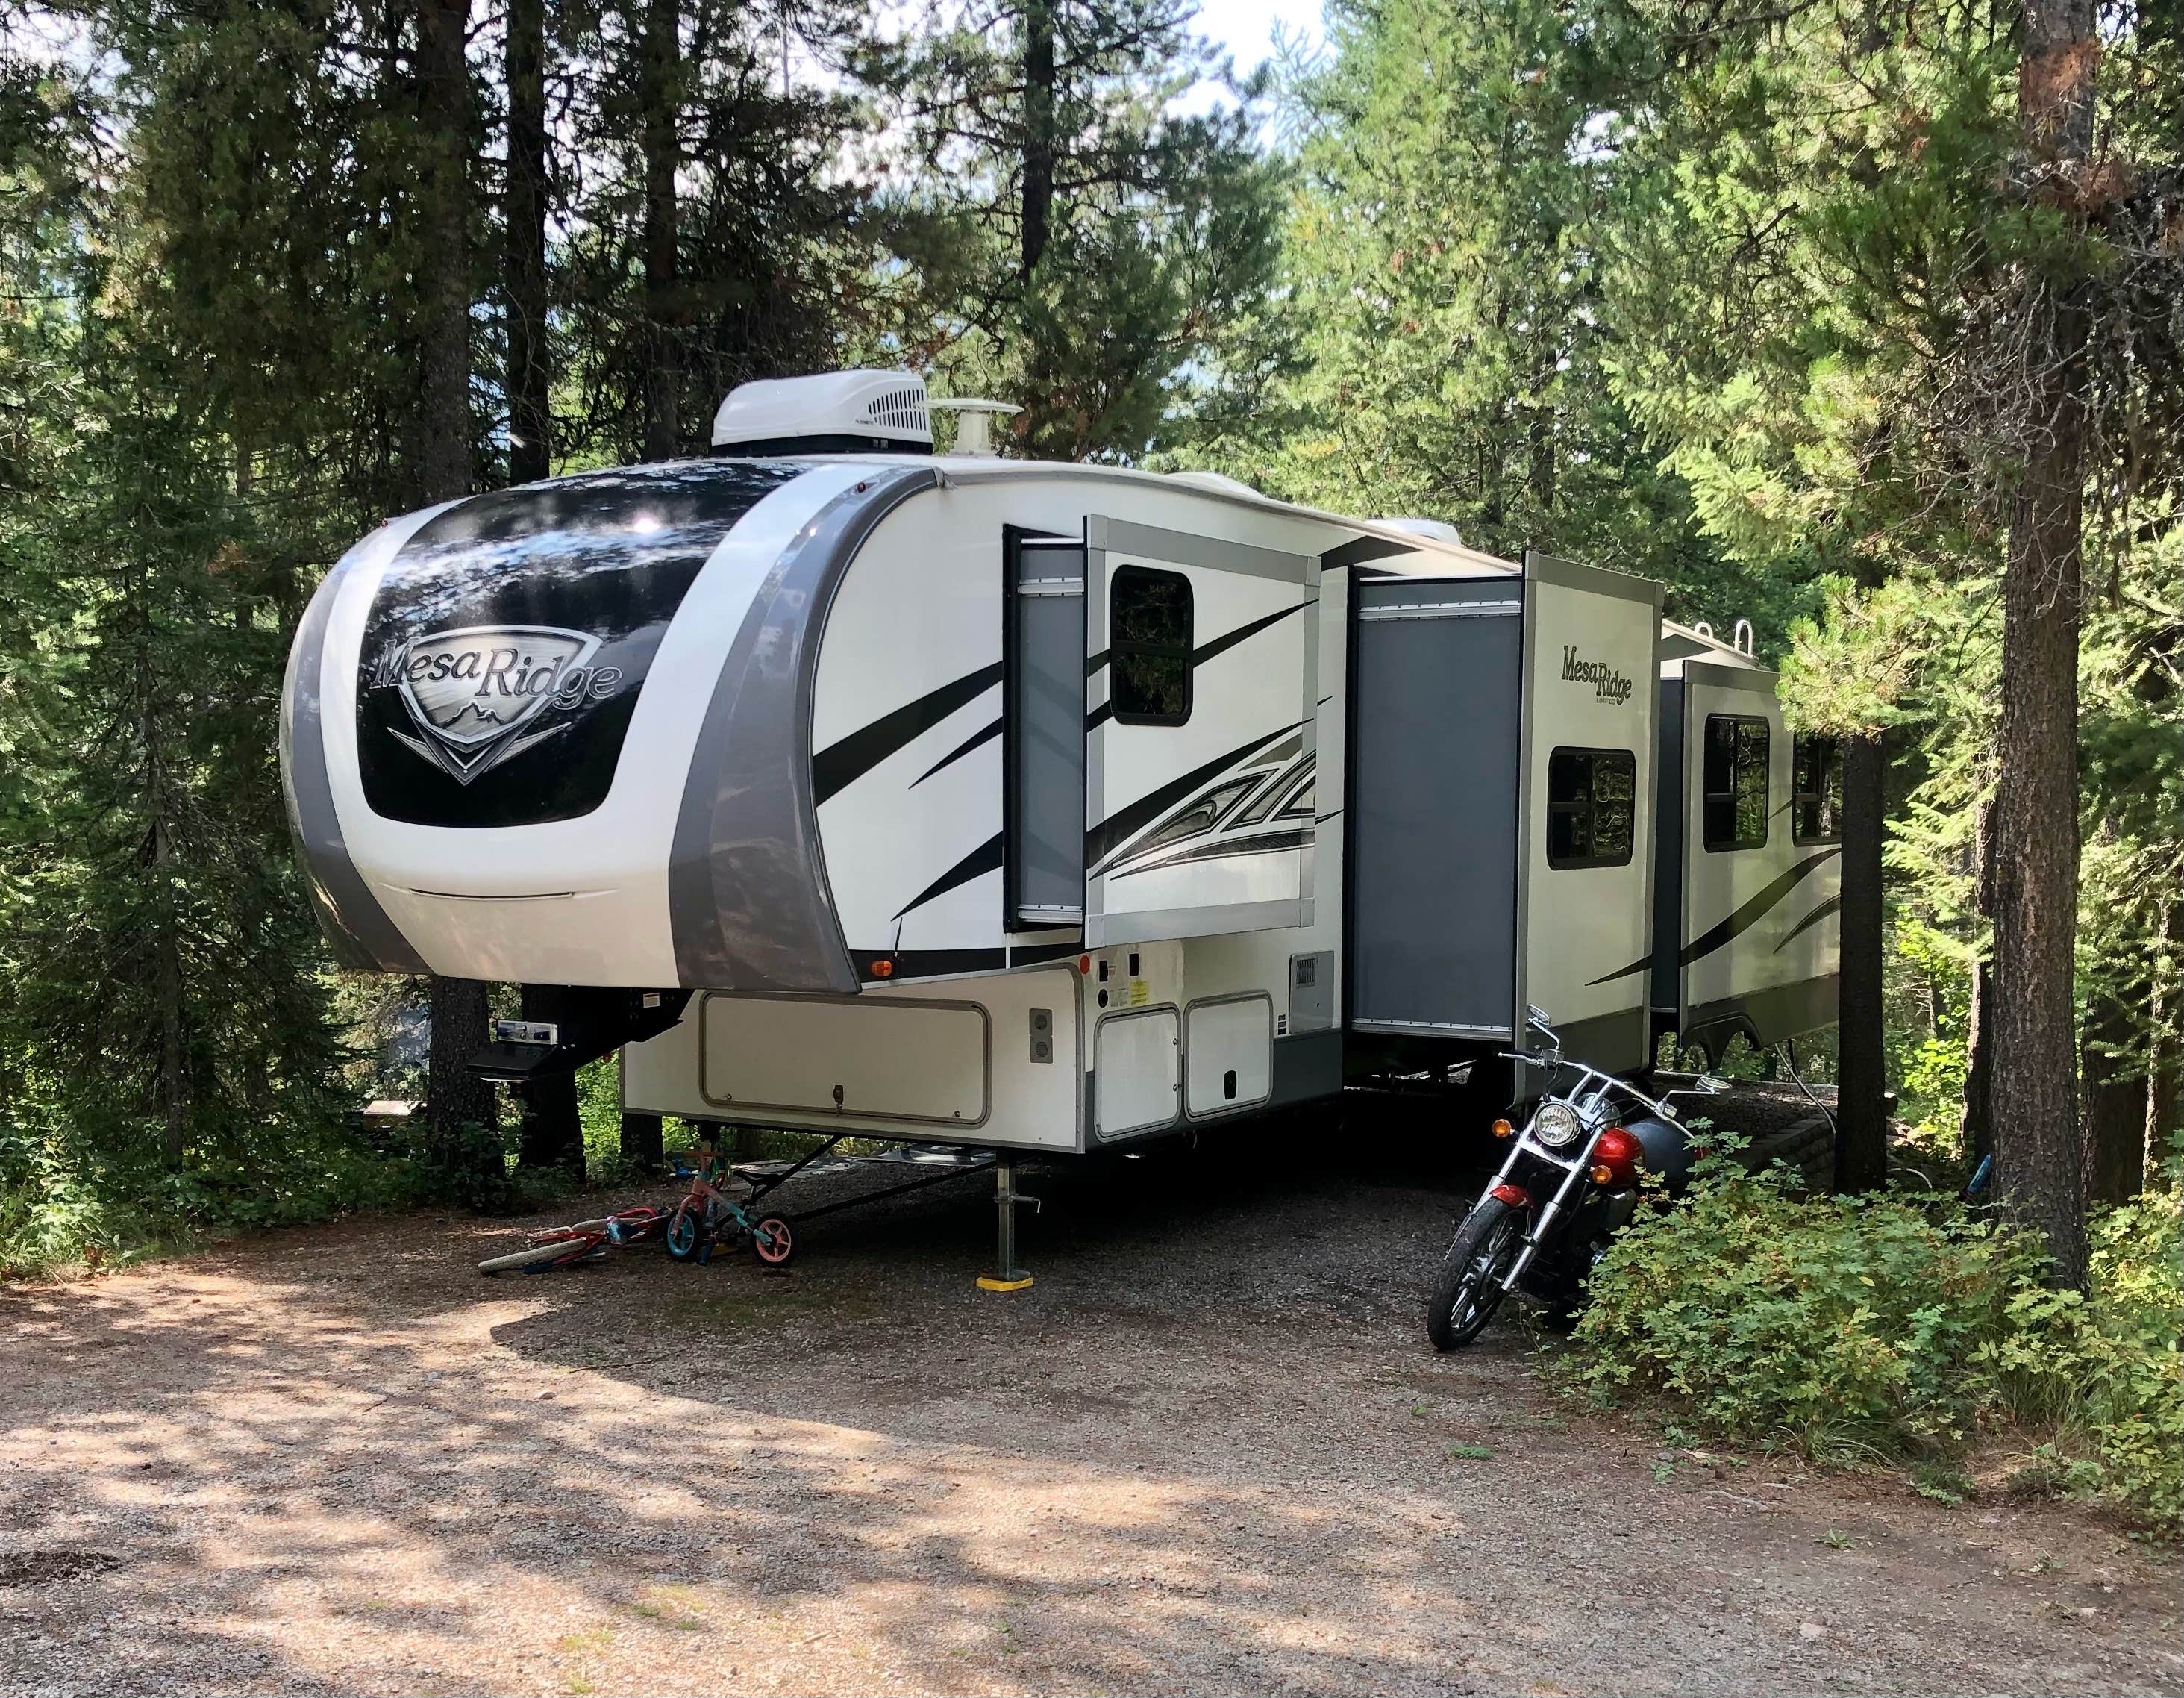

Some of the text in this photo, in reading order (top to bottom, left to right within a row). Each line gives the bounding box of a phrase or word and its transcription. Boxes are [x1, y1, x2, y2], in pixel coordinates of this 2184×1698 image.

[369, 636, 622, 710] Mesa Ridge
[1561, 645, 1632, 705] Mesa Ridge
